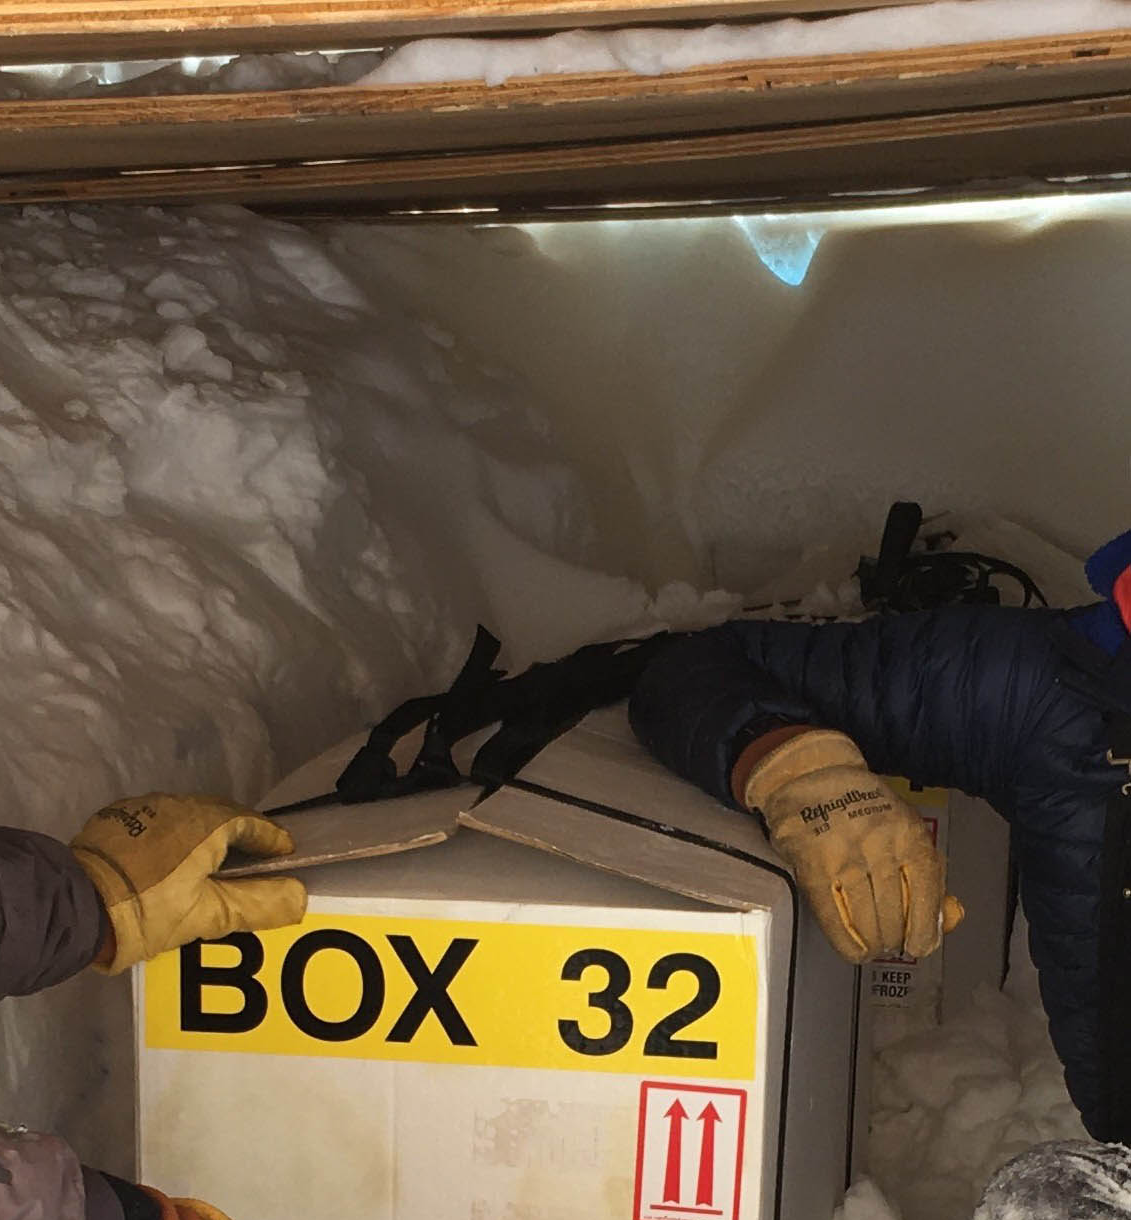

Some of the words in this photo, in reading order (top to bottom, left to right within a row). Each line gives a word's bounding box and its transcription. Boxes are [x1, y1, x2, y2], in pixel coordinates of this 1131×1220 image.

[179, 929, 478, 1047] BOX
[558, 948, 721, 1060] 32
[882, 971, 912, 985] KEEP
